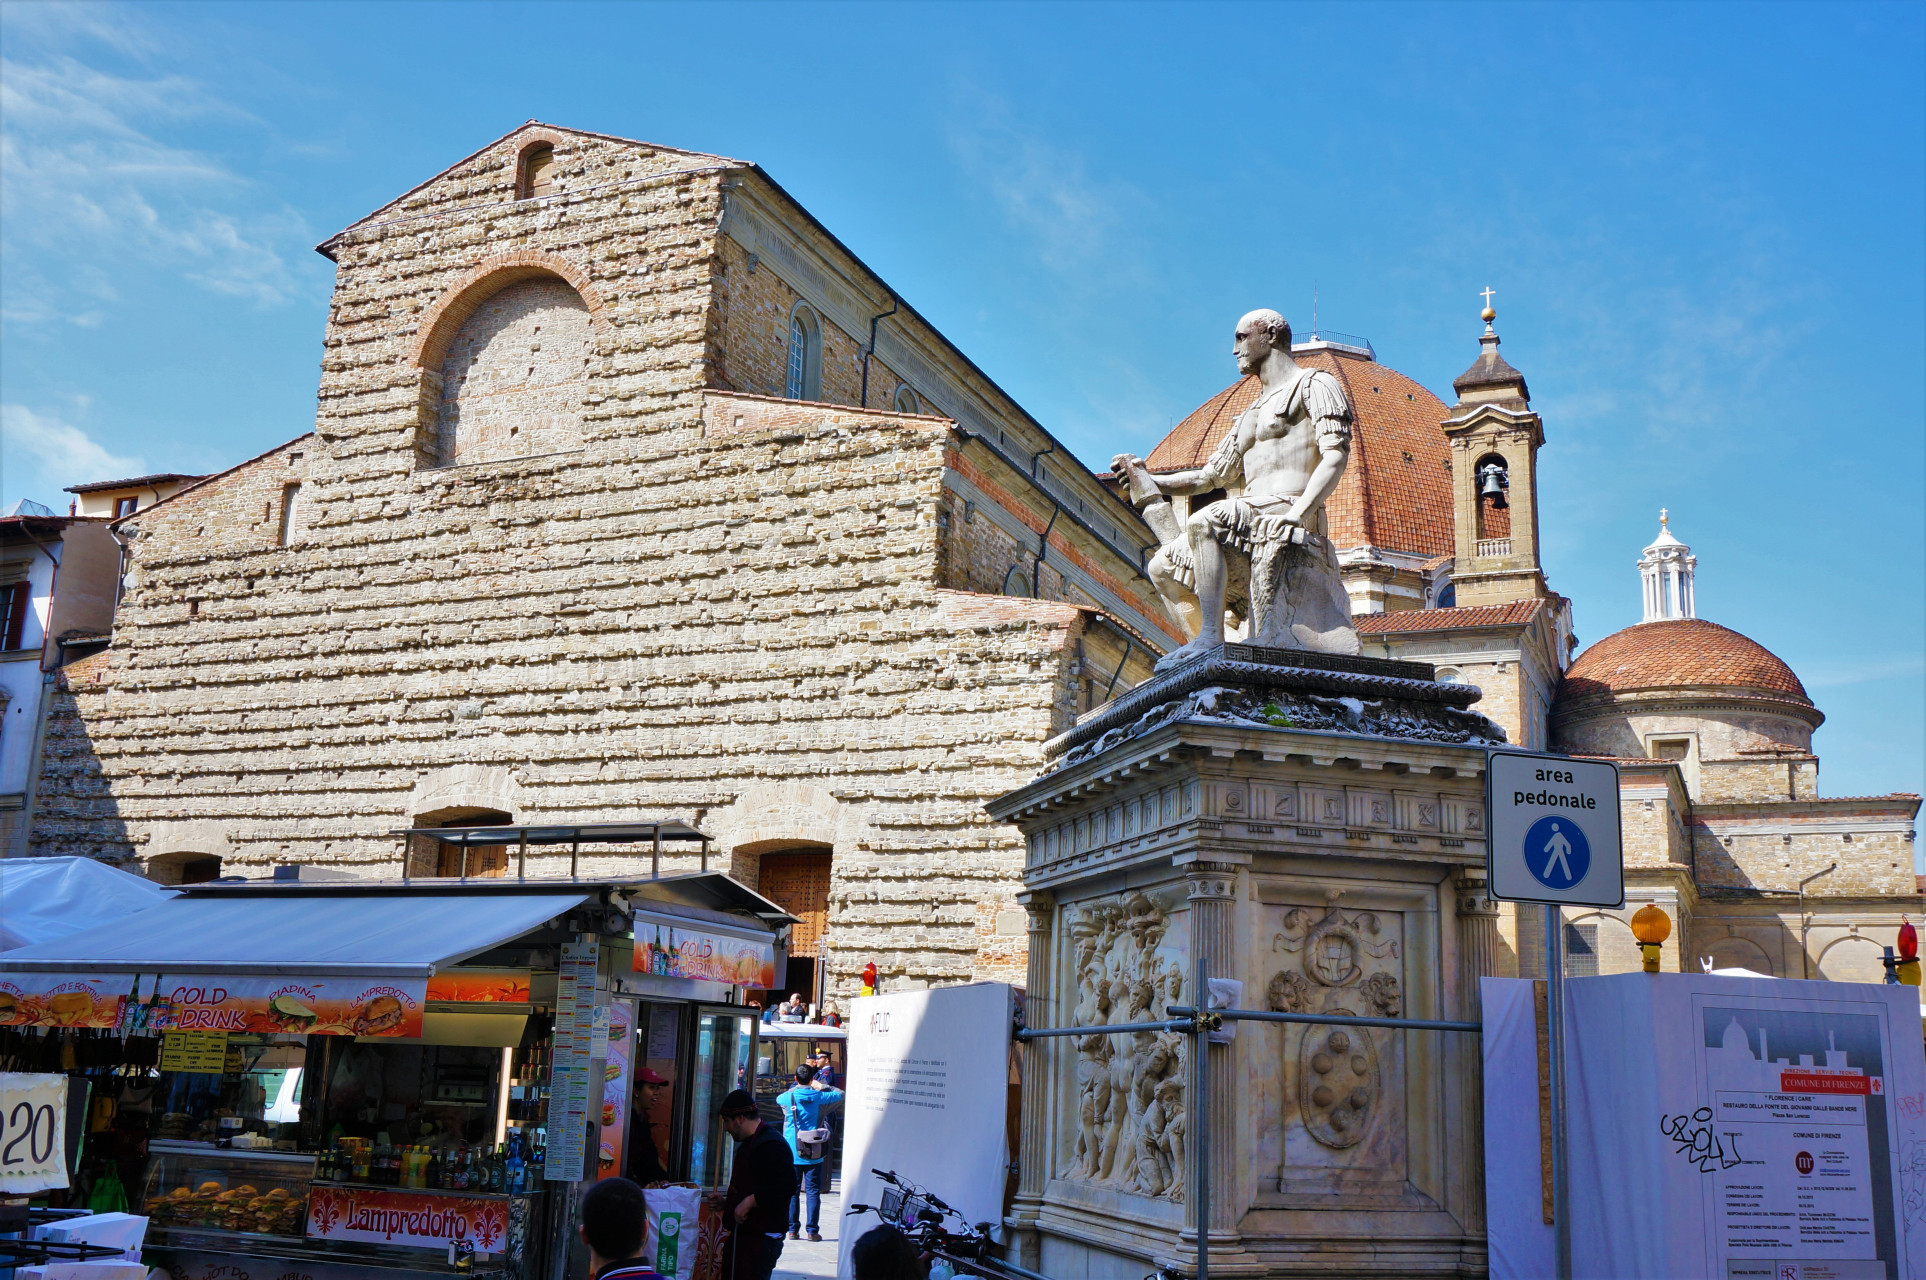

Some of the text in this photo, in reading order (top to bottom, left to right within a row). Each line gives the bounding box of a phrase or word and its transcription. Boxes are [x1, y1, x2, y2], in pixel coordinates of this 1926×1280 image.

[1535, 768, 1574, 784] area
[1514, 790, 1596, 810] pedonale
[680, 940, 713, 959] COLD
[686, 960, 725, 980] DRINK
[68, 981, 74, 991] E
[170, 986, 228, 1006] COLD
[268, 984, 317, 1005] PIADINA
[350, 986, 417, 1010] LAMPREDOTTO
[180, 1008, 247, 1029] DRINK
[1784, 1078, 1866, 1089] COMUNE DI FIRENZE
[0, 1101, 55, 1166] 20
[345, 1200, 467, 1240] Lampredotto
[660, 1247, 668, 1271] FARINA
